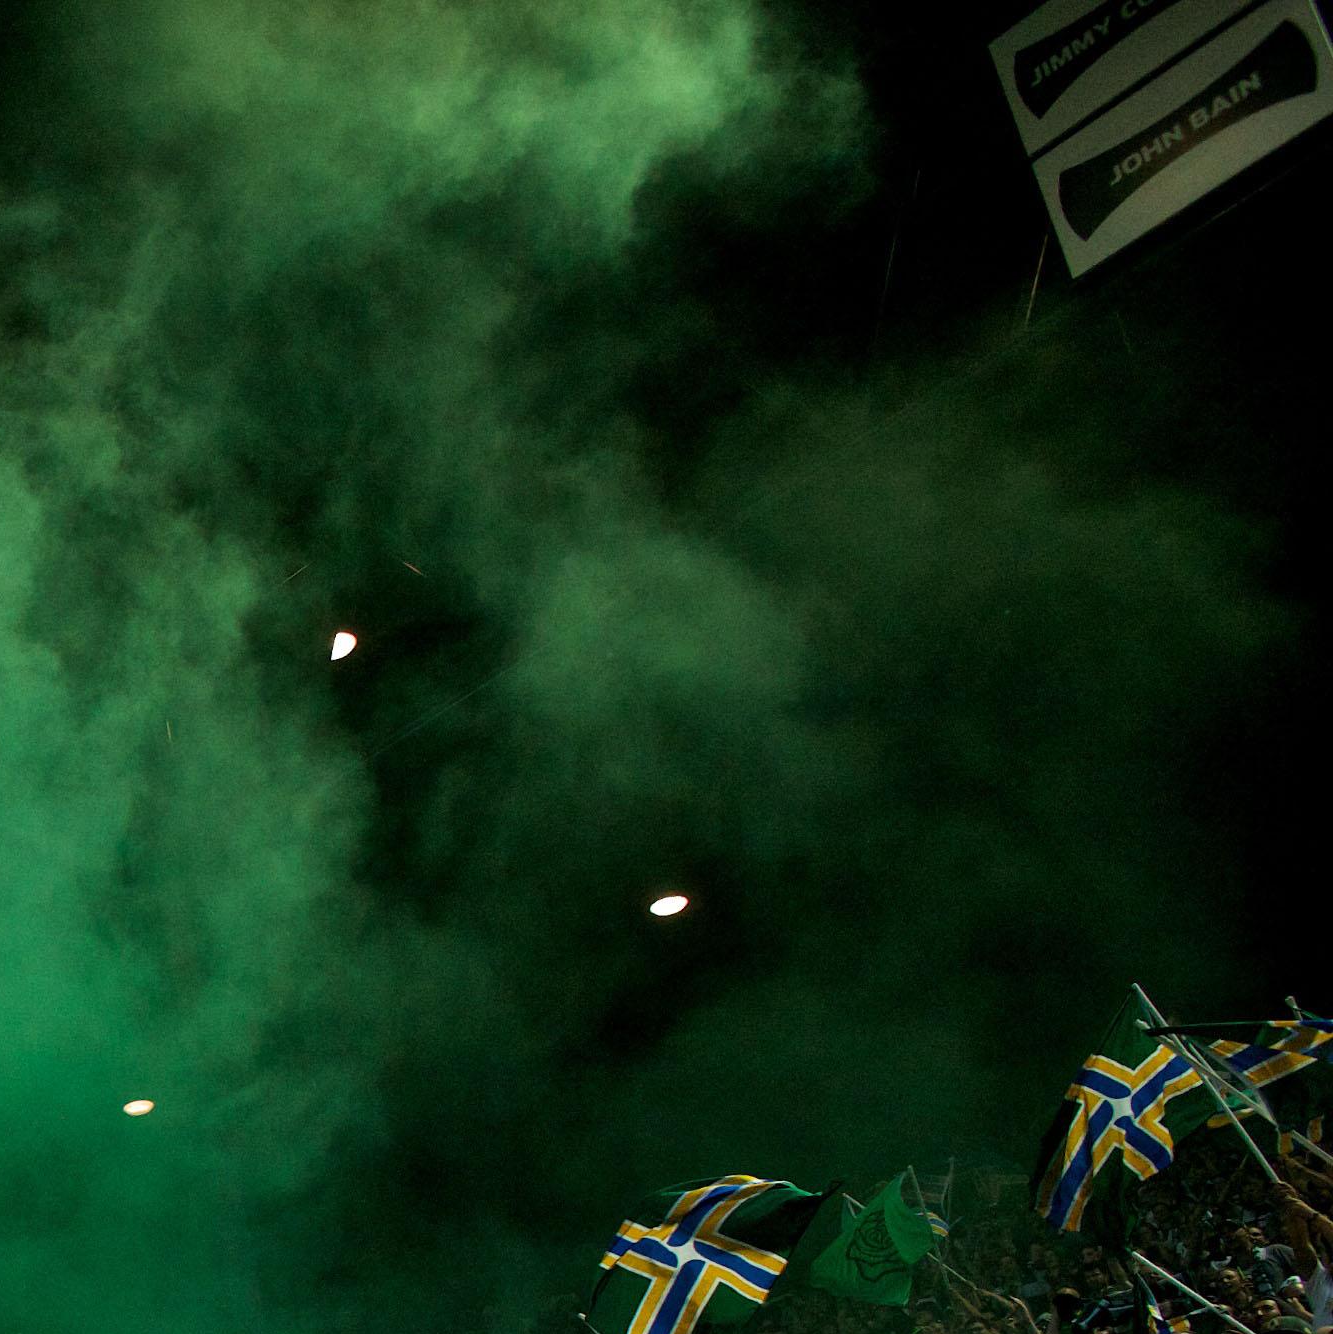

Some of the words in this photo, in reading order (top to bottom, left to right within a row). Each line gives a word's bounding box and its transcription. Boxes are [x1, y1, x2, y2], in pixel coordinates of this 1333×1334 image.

[1030, 15, 1112, 87] JIMMY
[1110, 124, 1186, 187] JOHN
[1188, 70, 1264, 131] BAIN
